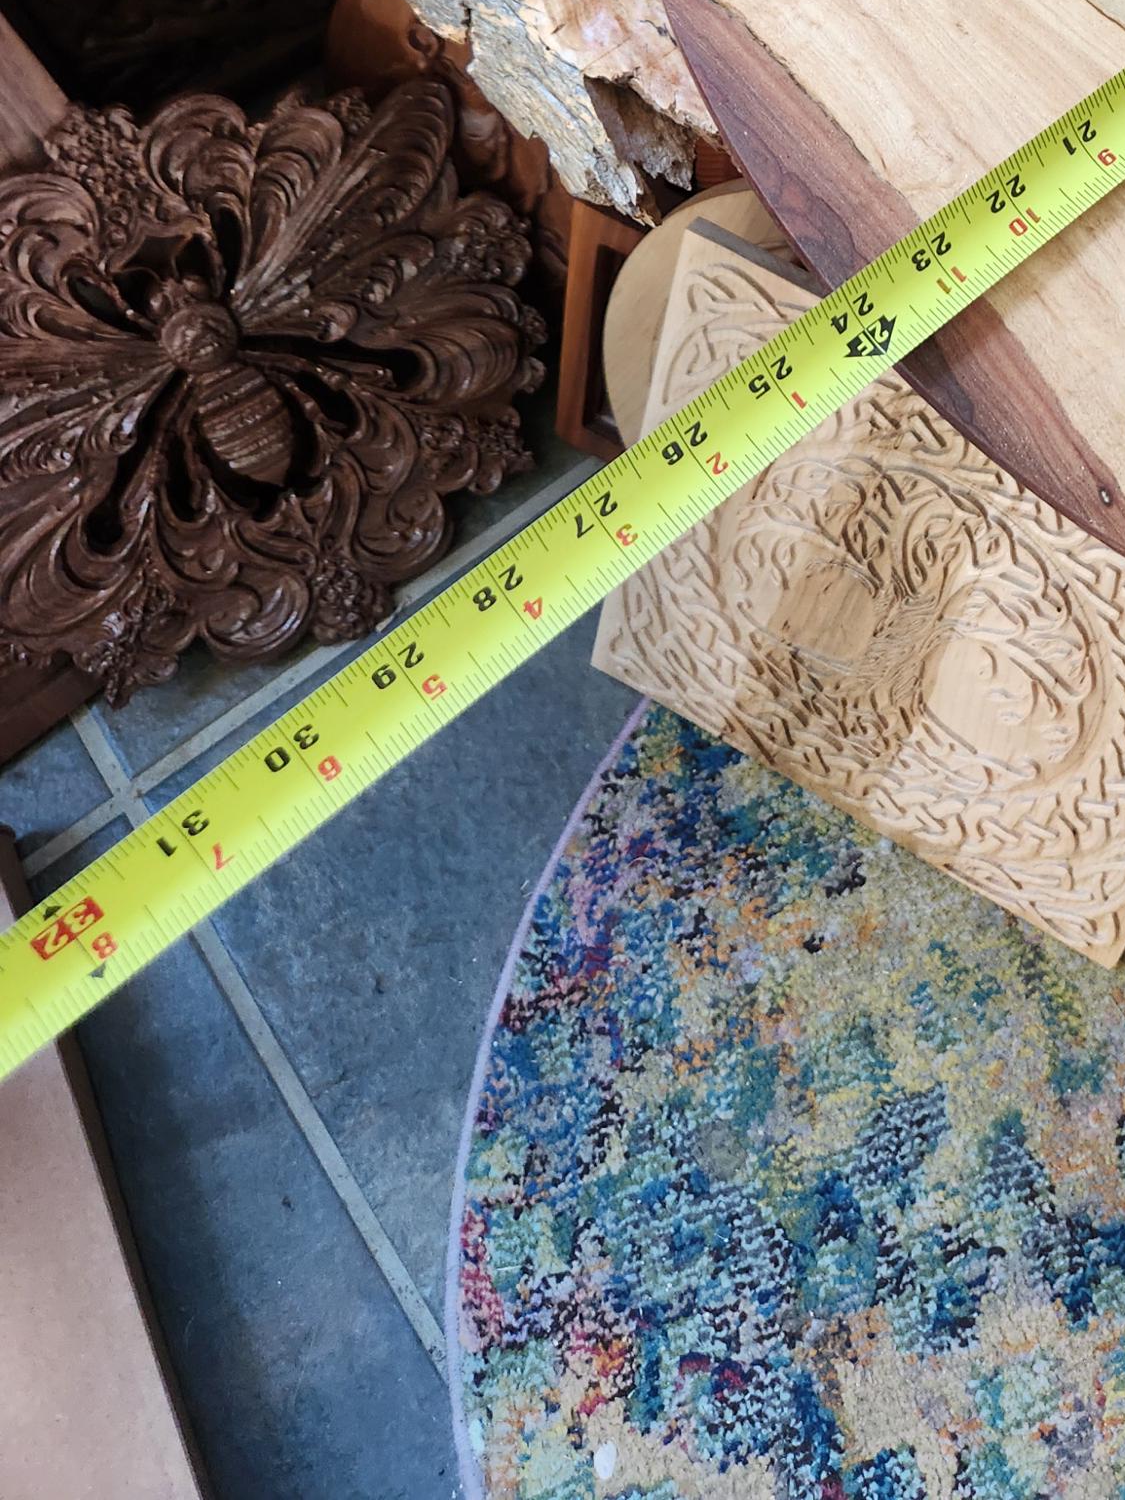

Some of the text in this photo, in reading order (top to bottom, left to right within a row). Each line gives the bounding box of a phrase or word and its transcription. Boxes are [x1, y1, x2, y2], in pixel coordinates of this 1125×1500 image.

[1062, 120, 1096, 156] 21
[1097, 148, 1117, 167] 9
[985, 175, 1026, 214] 22
[1009, 207, 1041, 237] 10
[911, 232, 951, 272] 23
[937, 266, 968, 295] 11
[830, 293, 874, 334] 24
[748, 355, 793, 399] 25
[661, 421, 708, 466] 26
[574, 491, 618, 539] 27
[472, 565, 523, 612] 28
[91, 391, 807, 959] 1 2 3 4 5 6 7 8
[371, 642, 424, 690] 29
[264, 724, 319, 773] 30
[156, 809, 210, 857] 31
[39, 900, 101, 956] 32
